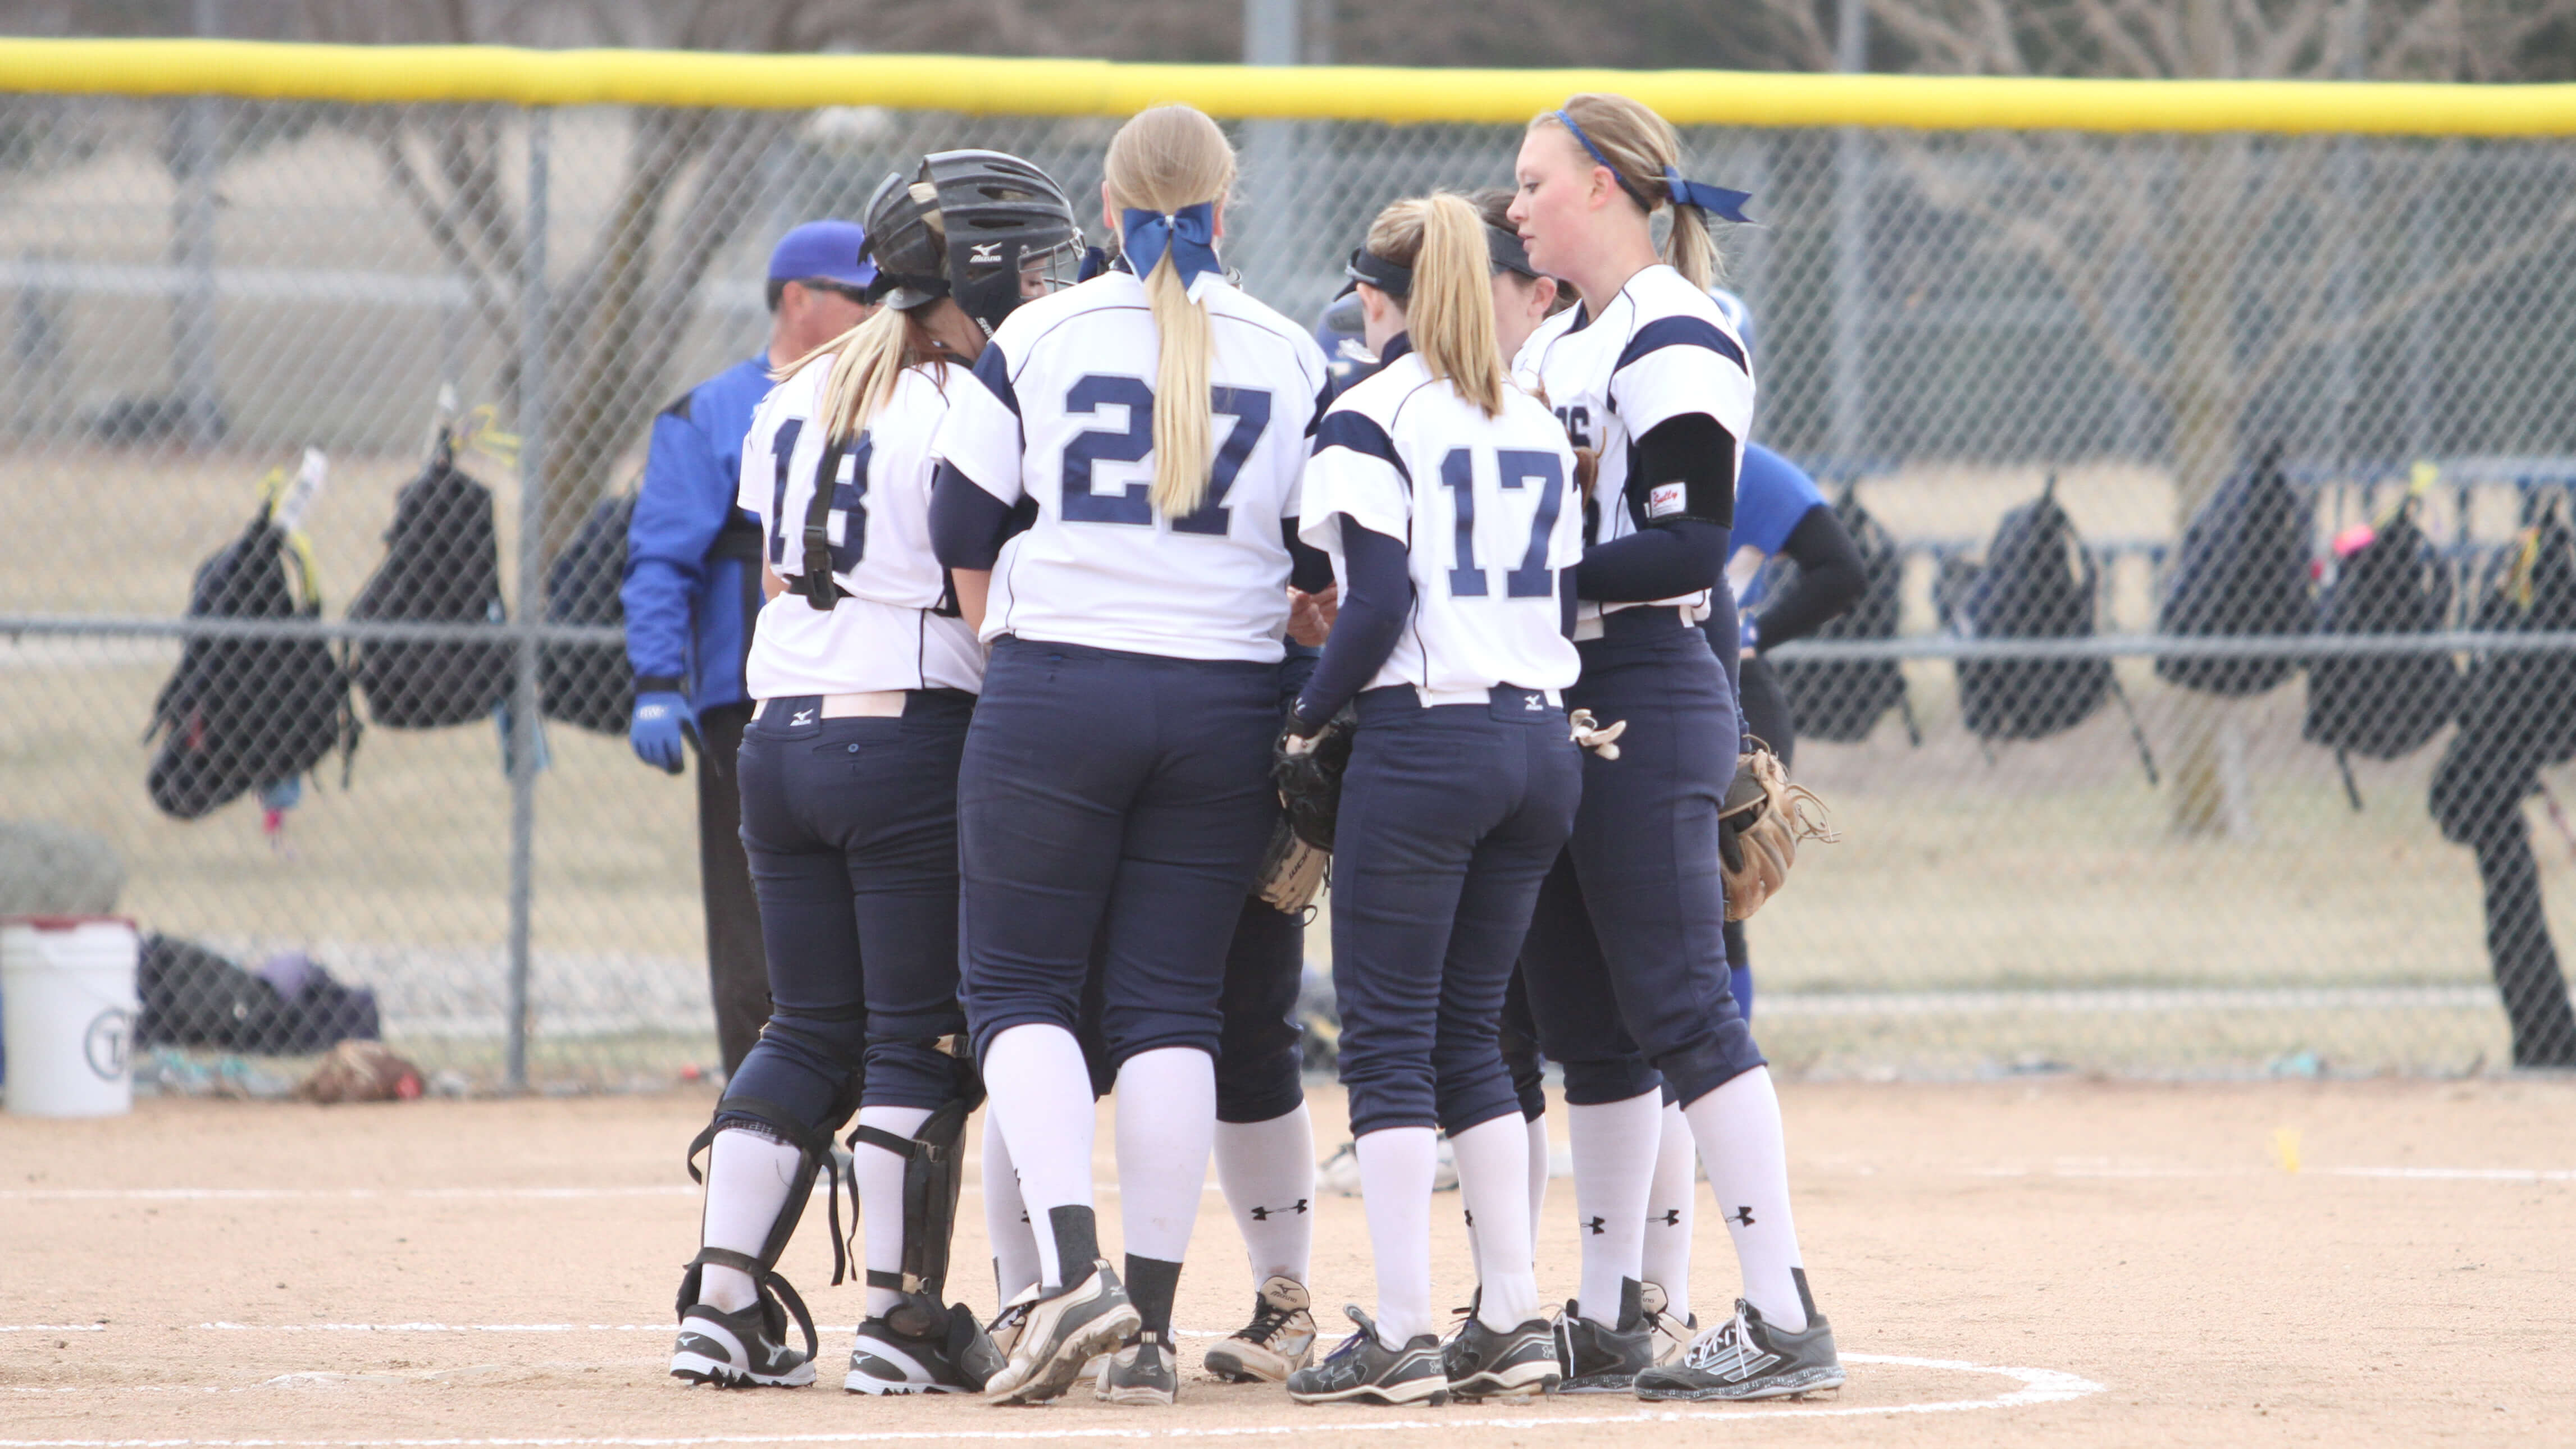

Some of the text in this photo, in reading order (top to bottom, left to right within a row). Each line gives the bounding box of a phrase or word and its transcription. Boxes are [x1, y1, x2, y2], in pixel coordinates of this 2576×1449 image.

[768, 415, 874, 577] 18
[1060, 373, 1274, 537] 27
[1439, 447, 1565, 598] 17
